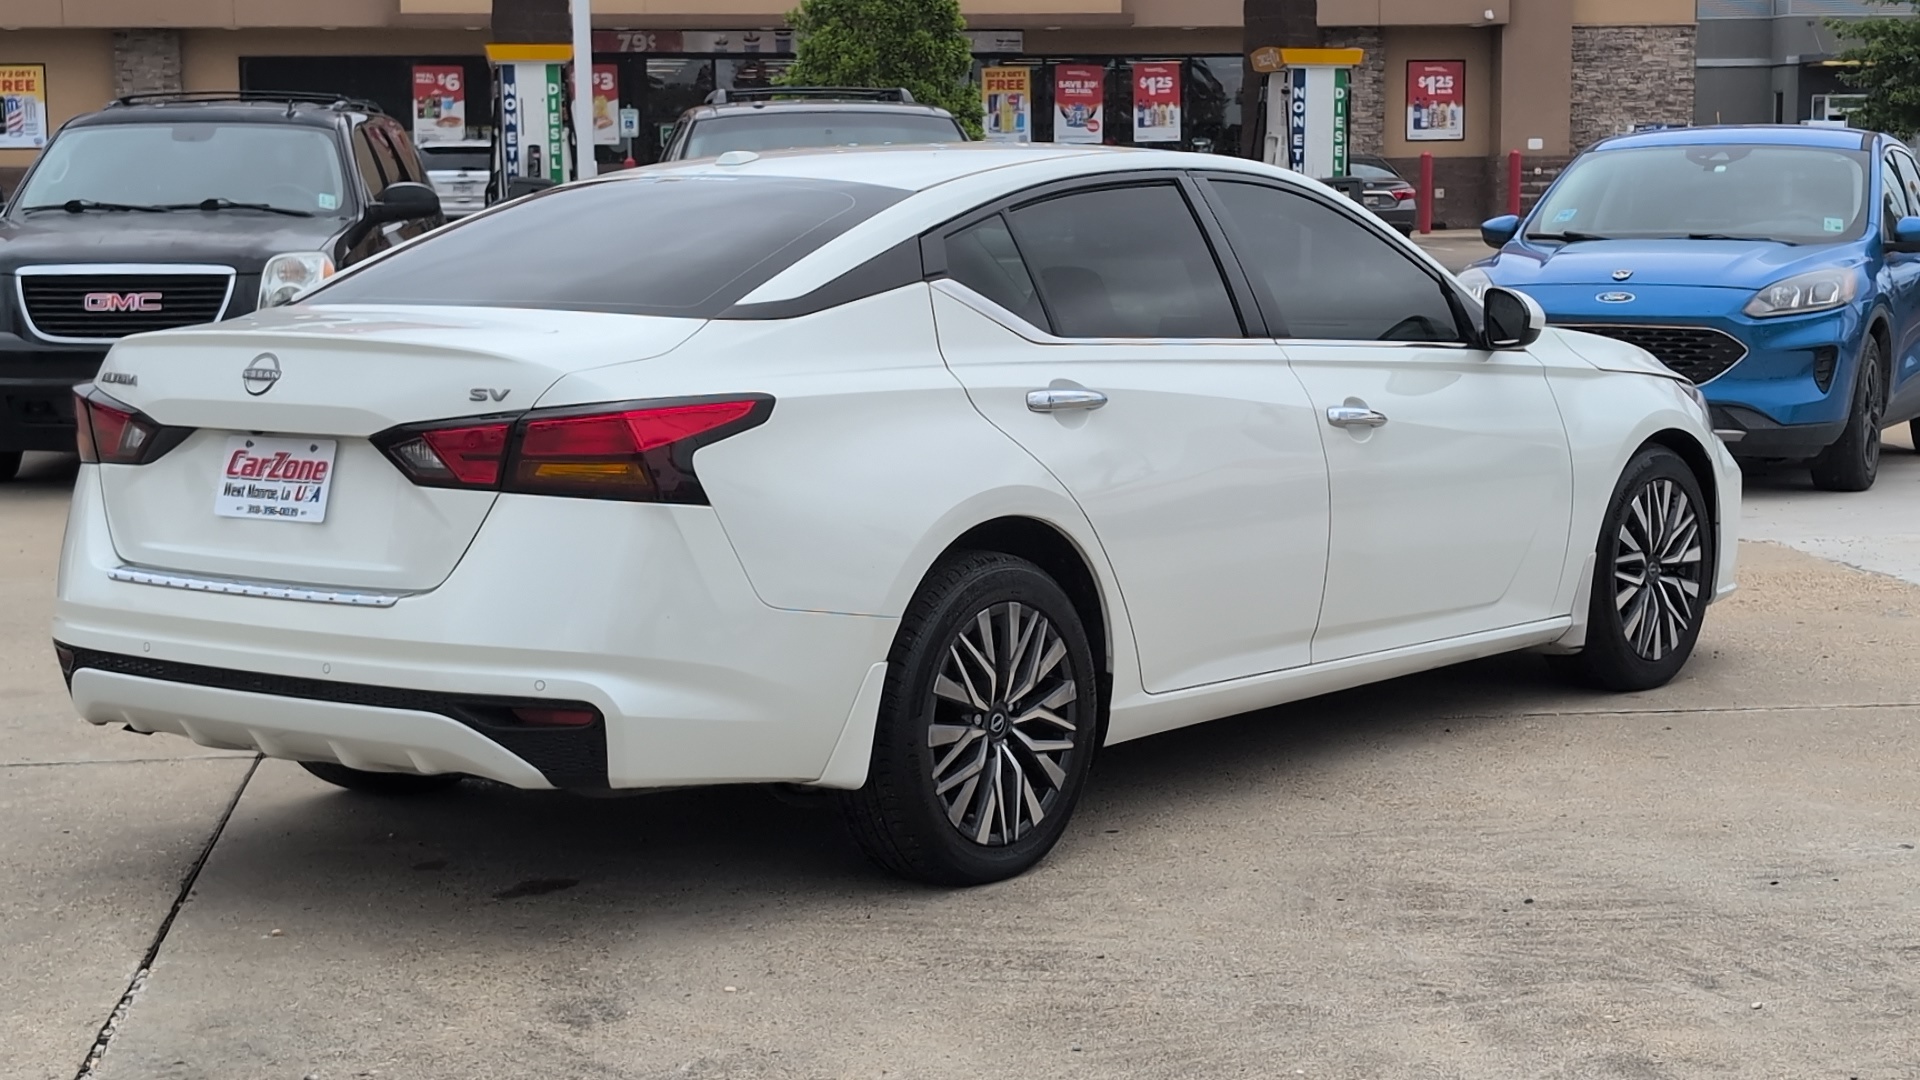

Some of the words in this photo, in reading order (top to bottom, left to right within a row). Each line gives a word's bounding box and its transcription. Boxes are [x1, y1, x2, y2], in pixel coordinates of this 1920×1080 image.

[0, 79, 36, 92] REE
[437, 72, 460, 91] $6
[593, 72, 614, 91] $3
[987, 79, 1025, 91] FREE
[1058, 80, 1082, 89] SAVE
[504, 83, 517, 125] NON
[1293, 86, 1304, 128] NON
[548, 83, 561, 170] DIESEL
[1334, 87, 1345, 171] DIESEL
[506, 132, 518, 174] ETH
[1292, 133, 1303, 175] ETH
[84, 291, 163, 312] GMC
[243, 368, 281, 381] NISSAN
[469, 388, 511, 402] SV
[226, 449, 329, 484] CarZone
[223, 482, 246, 498] West
[281, 486, 291, 501] La
